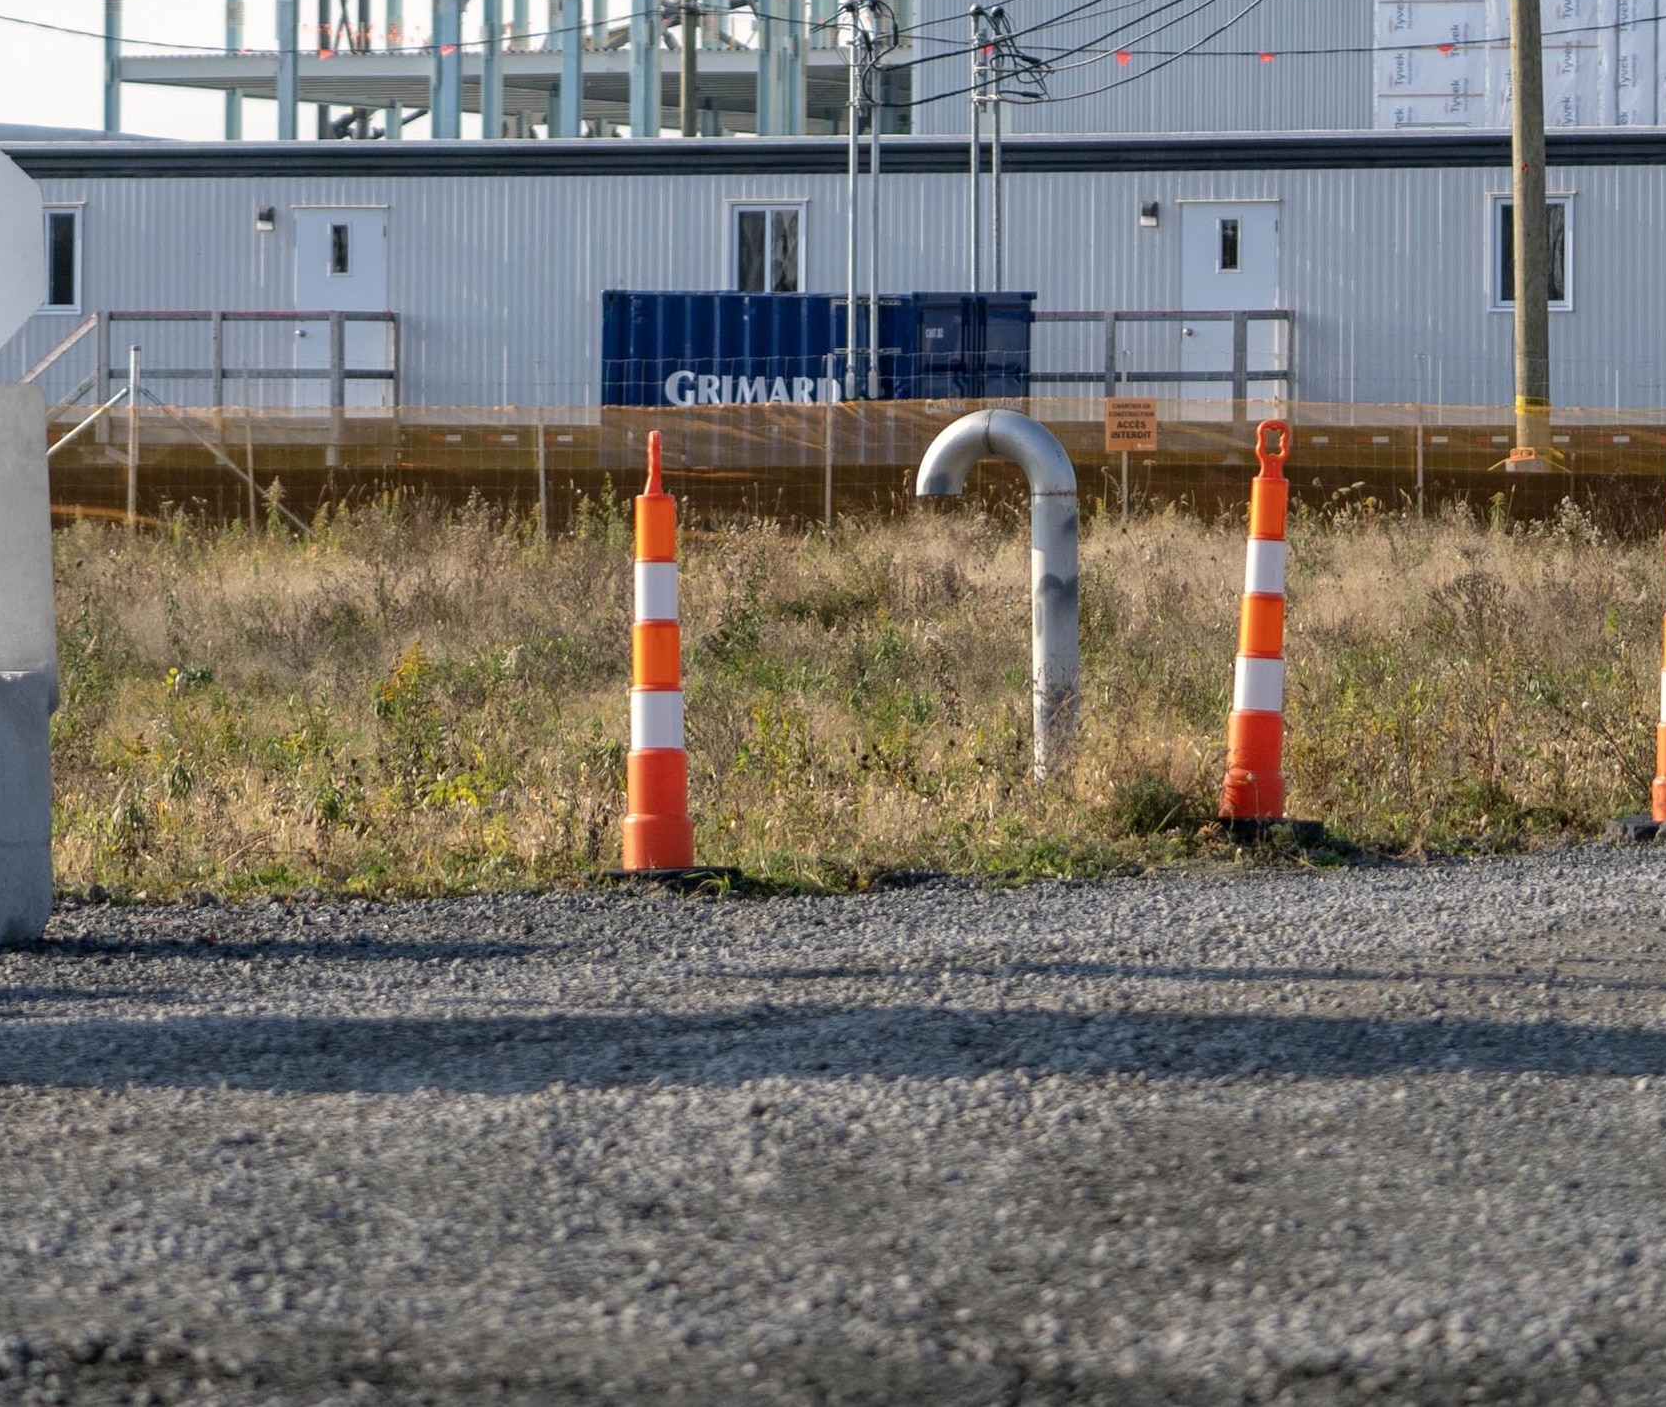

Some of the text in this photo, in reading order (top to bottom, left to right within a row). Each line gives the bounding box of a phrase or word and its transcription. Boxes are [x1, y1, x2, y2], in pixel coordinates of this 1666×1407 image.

[1394, 53, 1405, 85] Tyvek
[1618, 56, 1629, 88] Tyvek
[665, 370, 842, 406] GRIMARD
